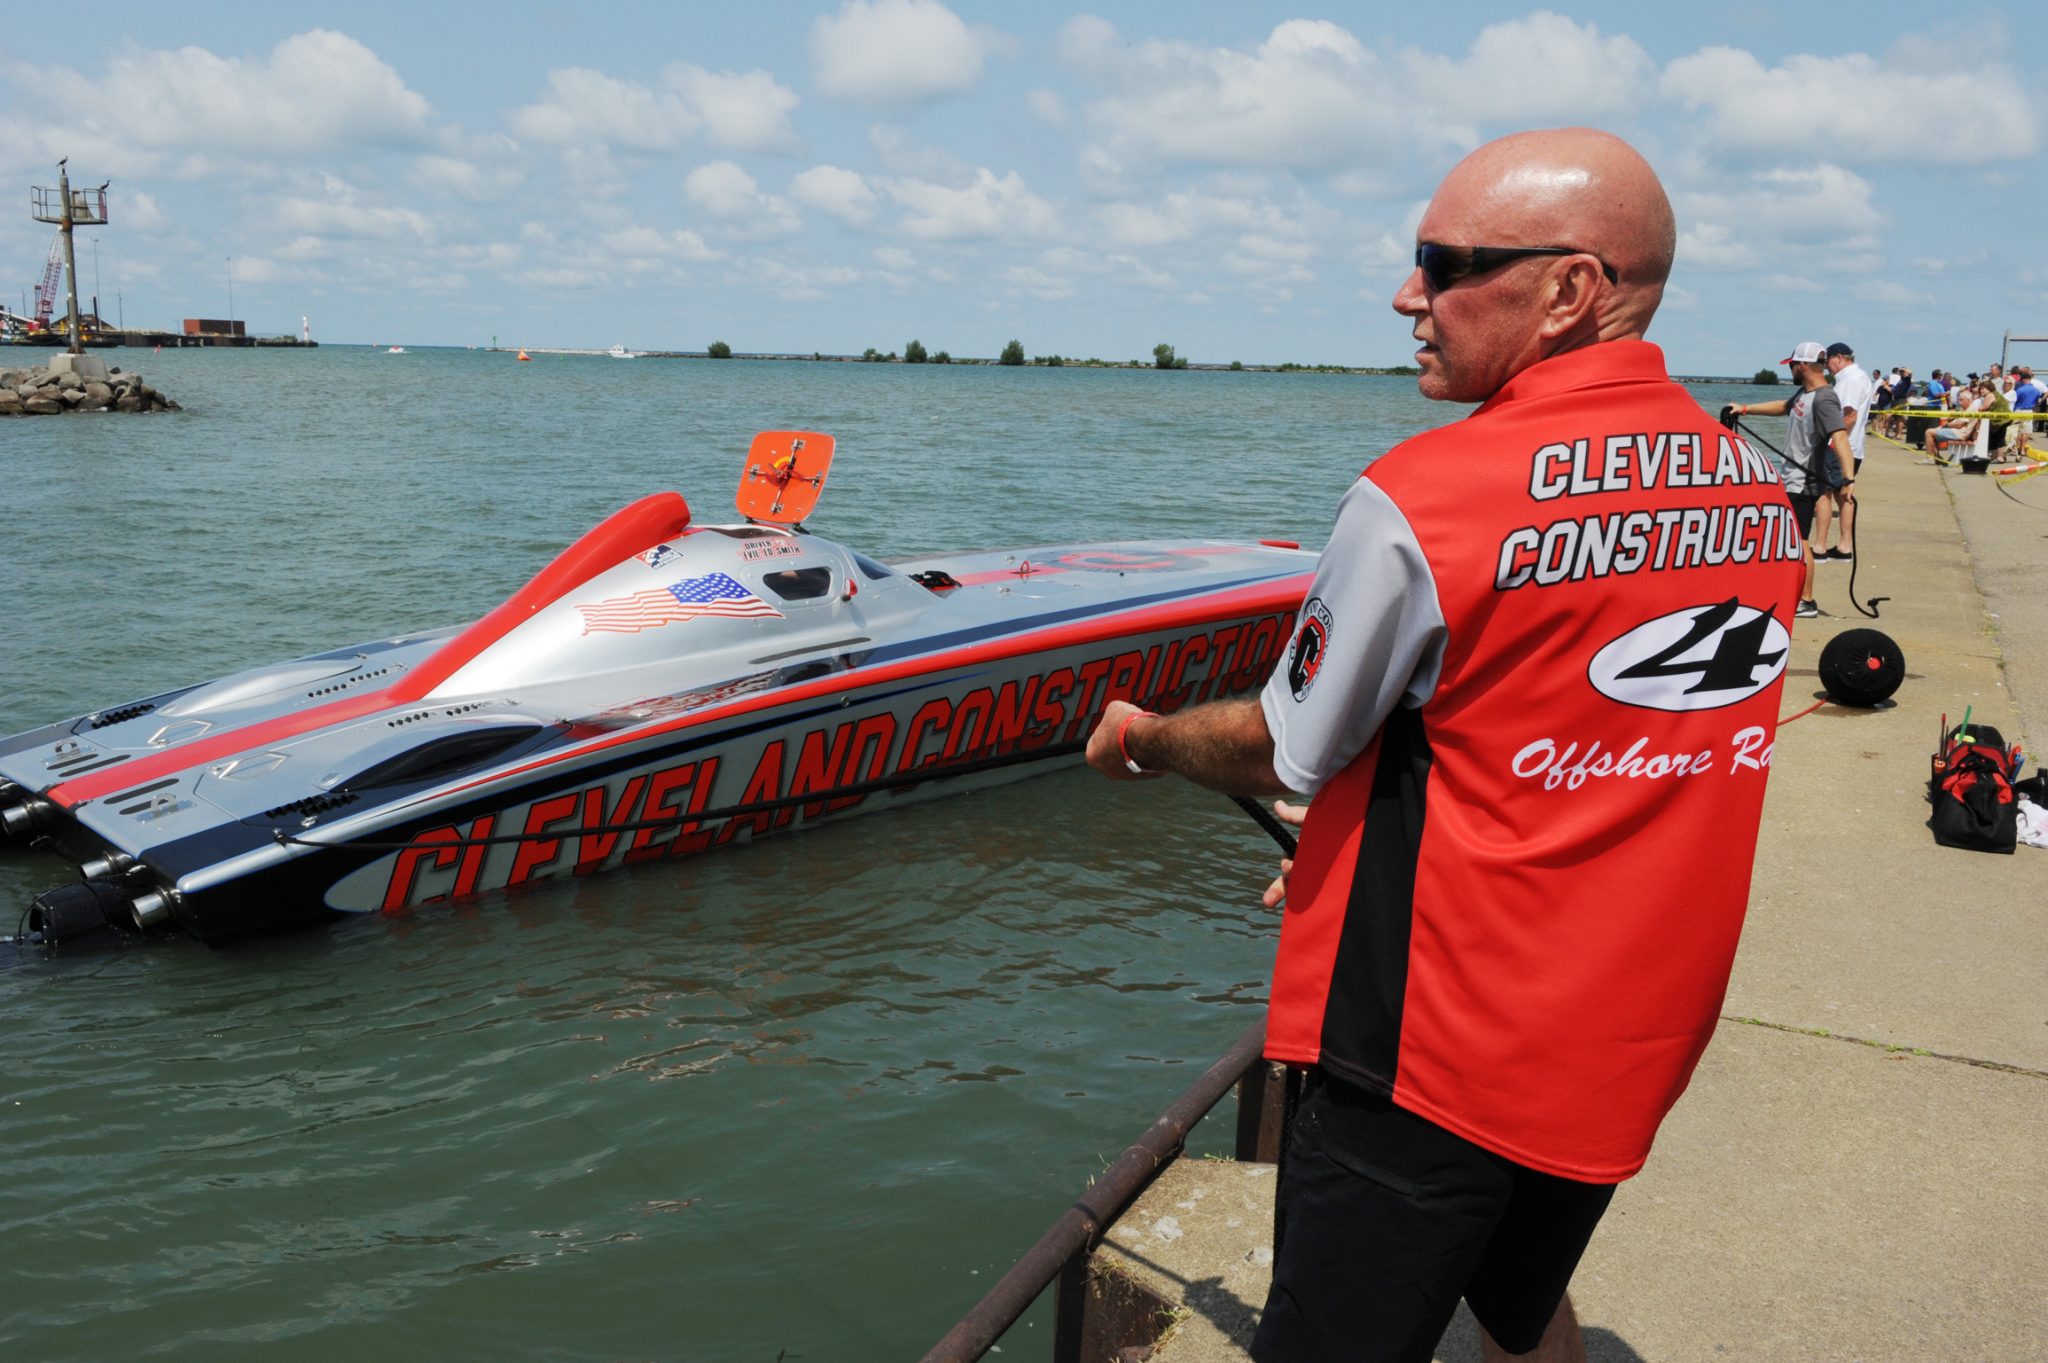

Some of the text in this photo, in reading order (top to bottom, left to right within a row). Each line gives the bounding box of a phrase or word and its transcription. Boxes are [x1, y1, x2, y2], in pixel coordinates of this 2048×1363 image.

[744, 540, 772, 550] DRIVER
[776, 546, 801, 555] SMITH
[1493, 503, 1804, 591] CONSTRUCTIO
[1613, 596, 1787, 695] 4
[1511, 737, 1713, 791] Offshore
